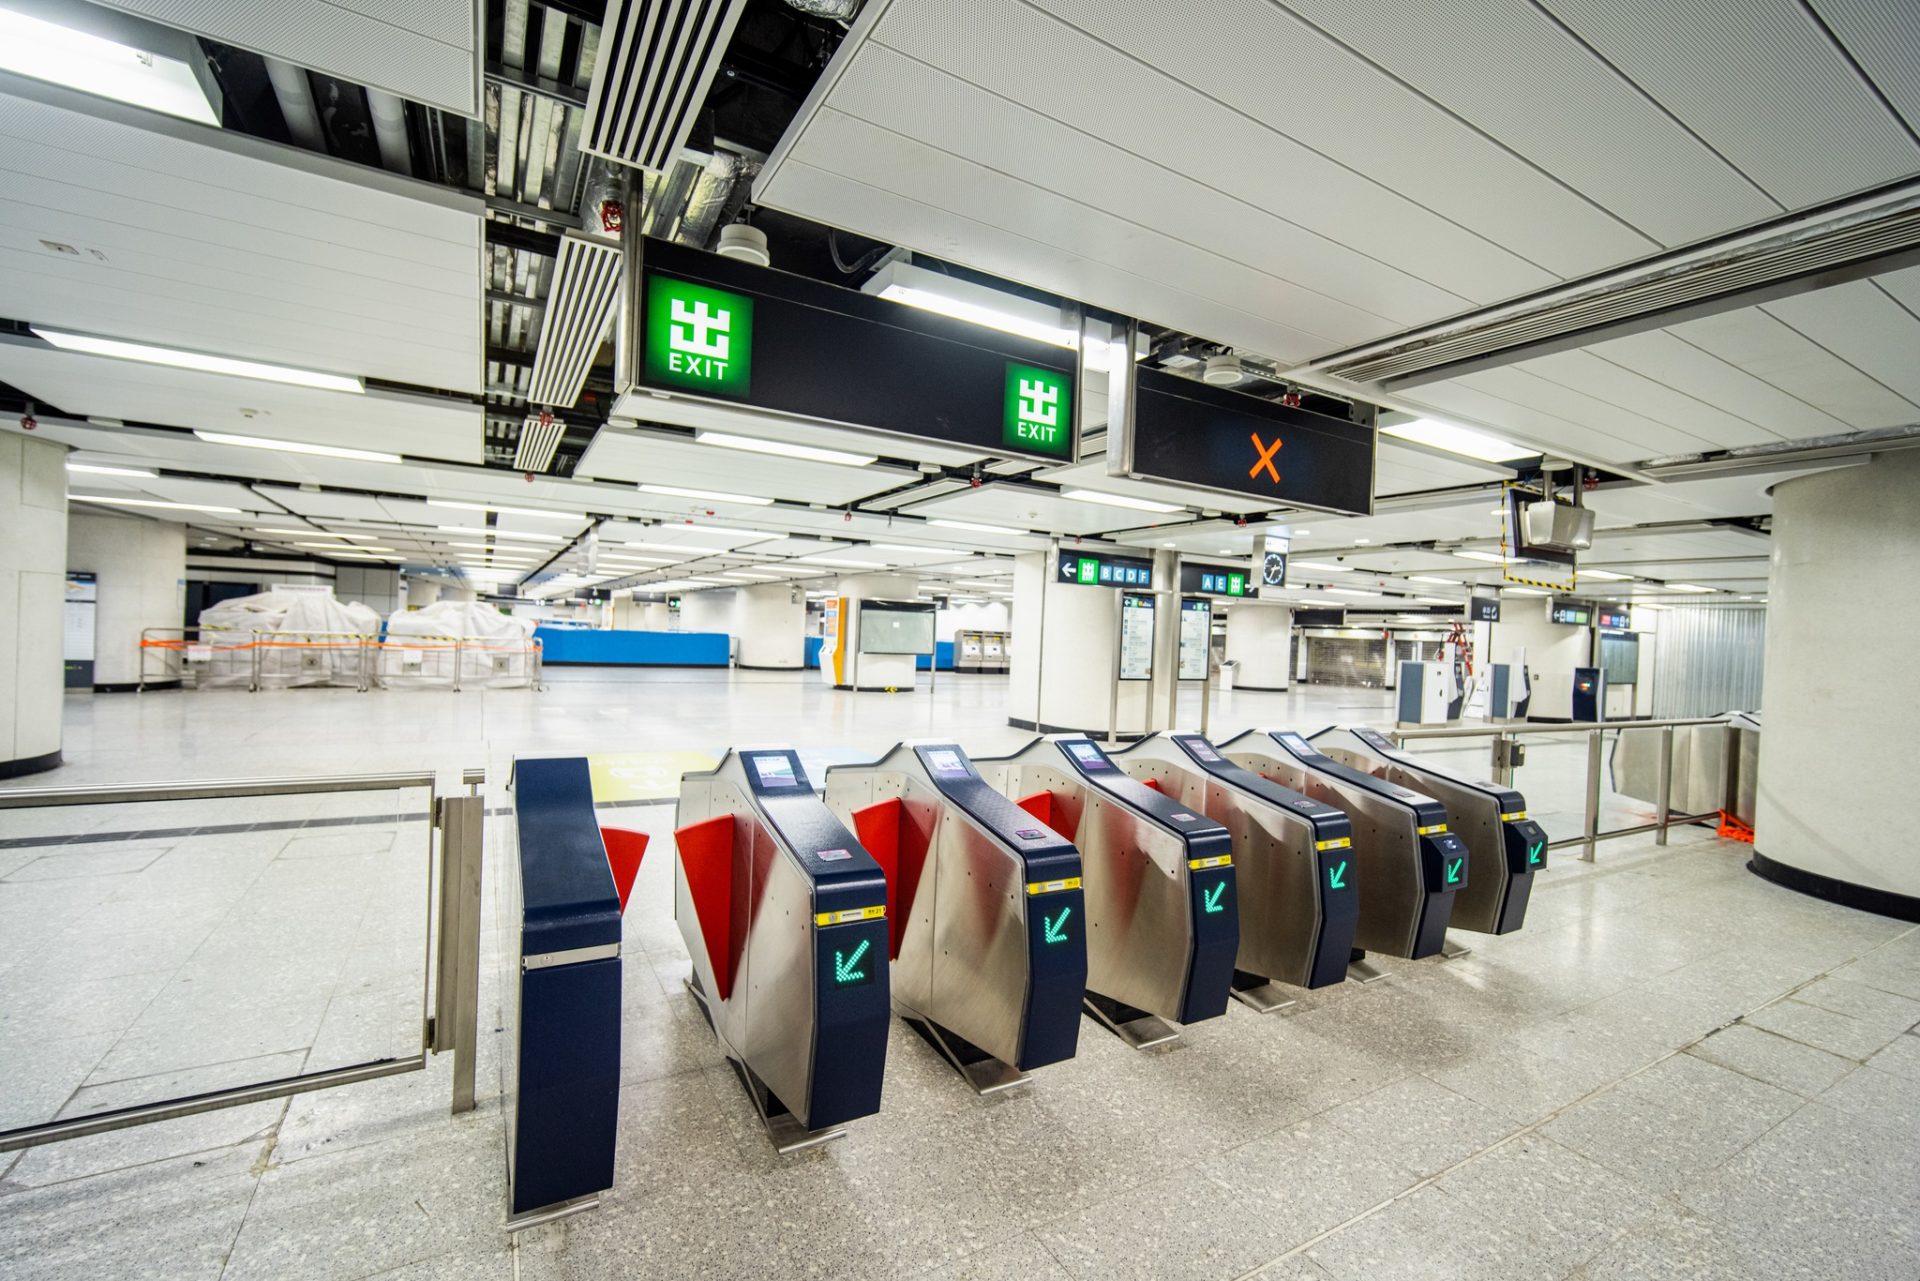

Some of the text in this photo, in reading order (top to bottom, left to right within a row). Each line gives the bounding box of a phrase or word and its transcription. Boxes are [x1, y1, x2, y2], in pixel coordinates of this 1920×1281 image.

[669, 351, 729, 380] EXIT
[1017, 421, 1057, 443] EXIT
[1102, 567, 1146, 582] B C D F
[1204, 577, 1223, 589] A E
